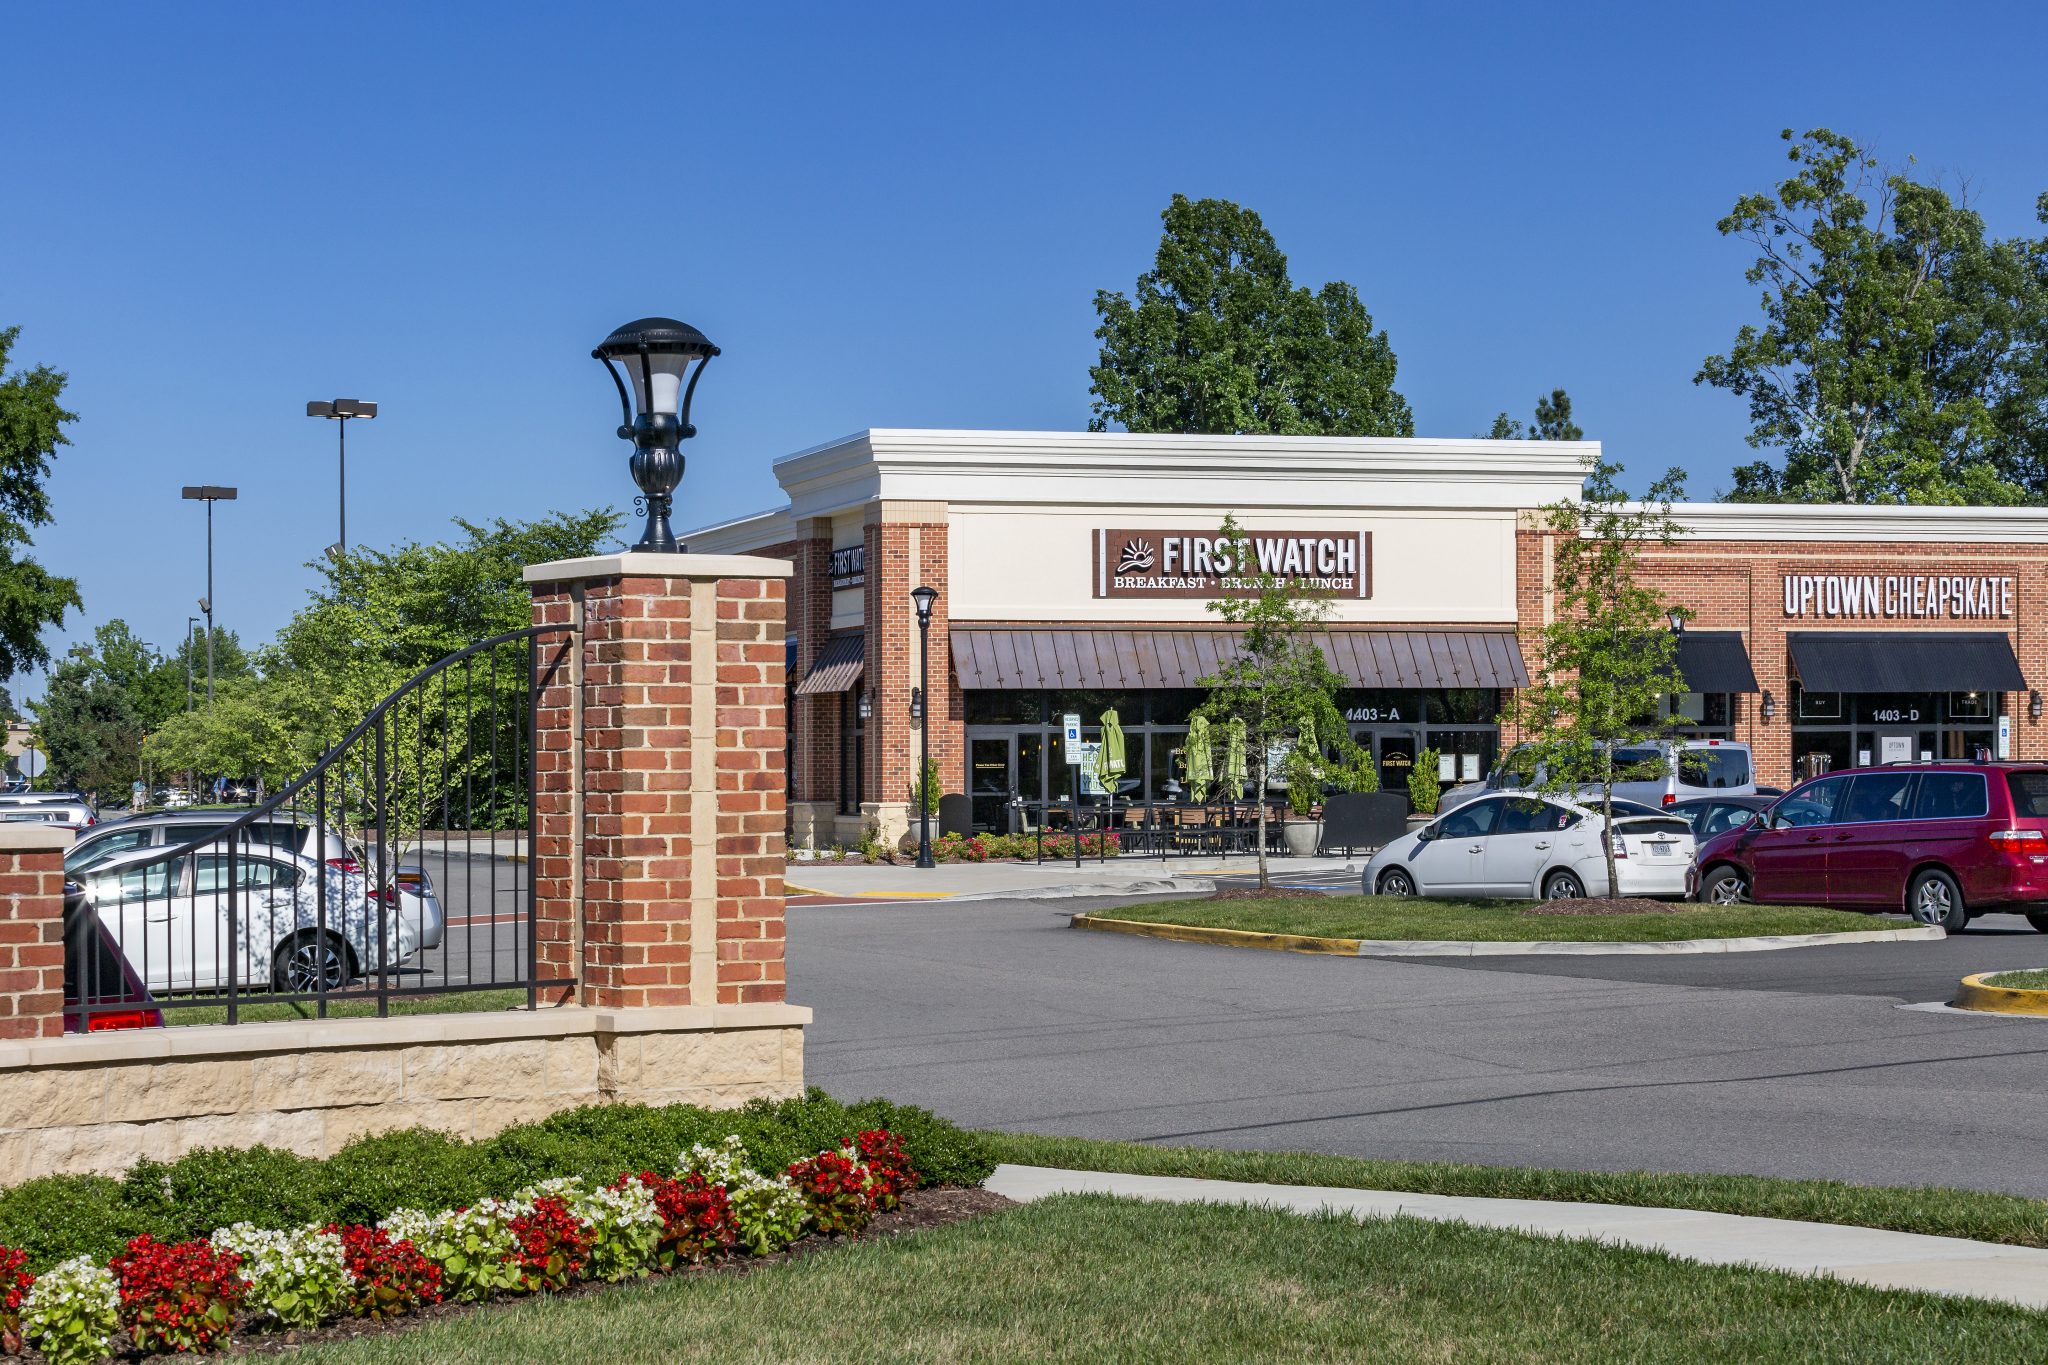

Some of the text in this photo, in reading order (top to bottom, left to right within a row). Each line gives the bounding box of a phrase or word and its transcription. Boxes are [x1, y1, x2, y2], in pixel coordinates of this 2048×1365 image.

[834, 548, 864, 575] FIRST WATC
[1163, 537, 1356, 574] FIRST WATCH
[1113, 576, 1206, 589] BREAKFAST
[1785, 575, 2013, 615] UPTOWN CHEAPSKATE
